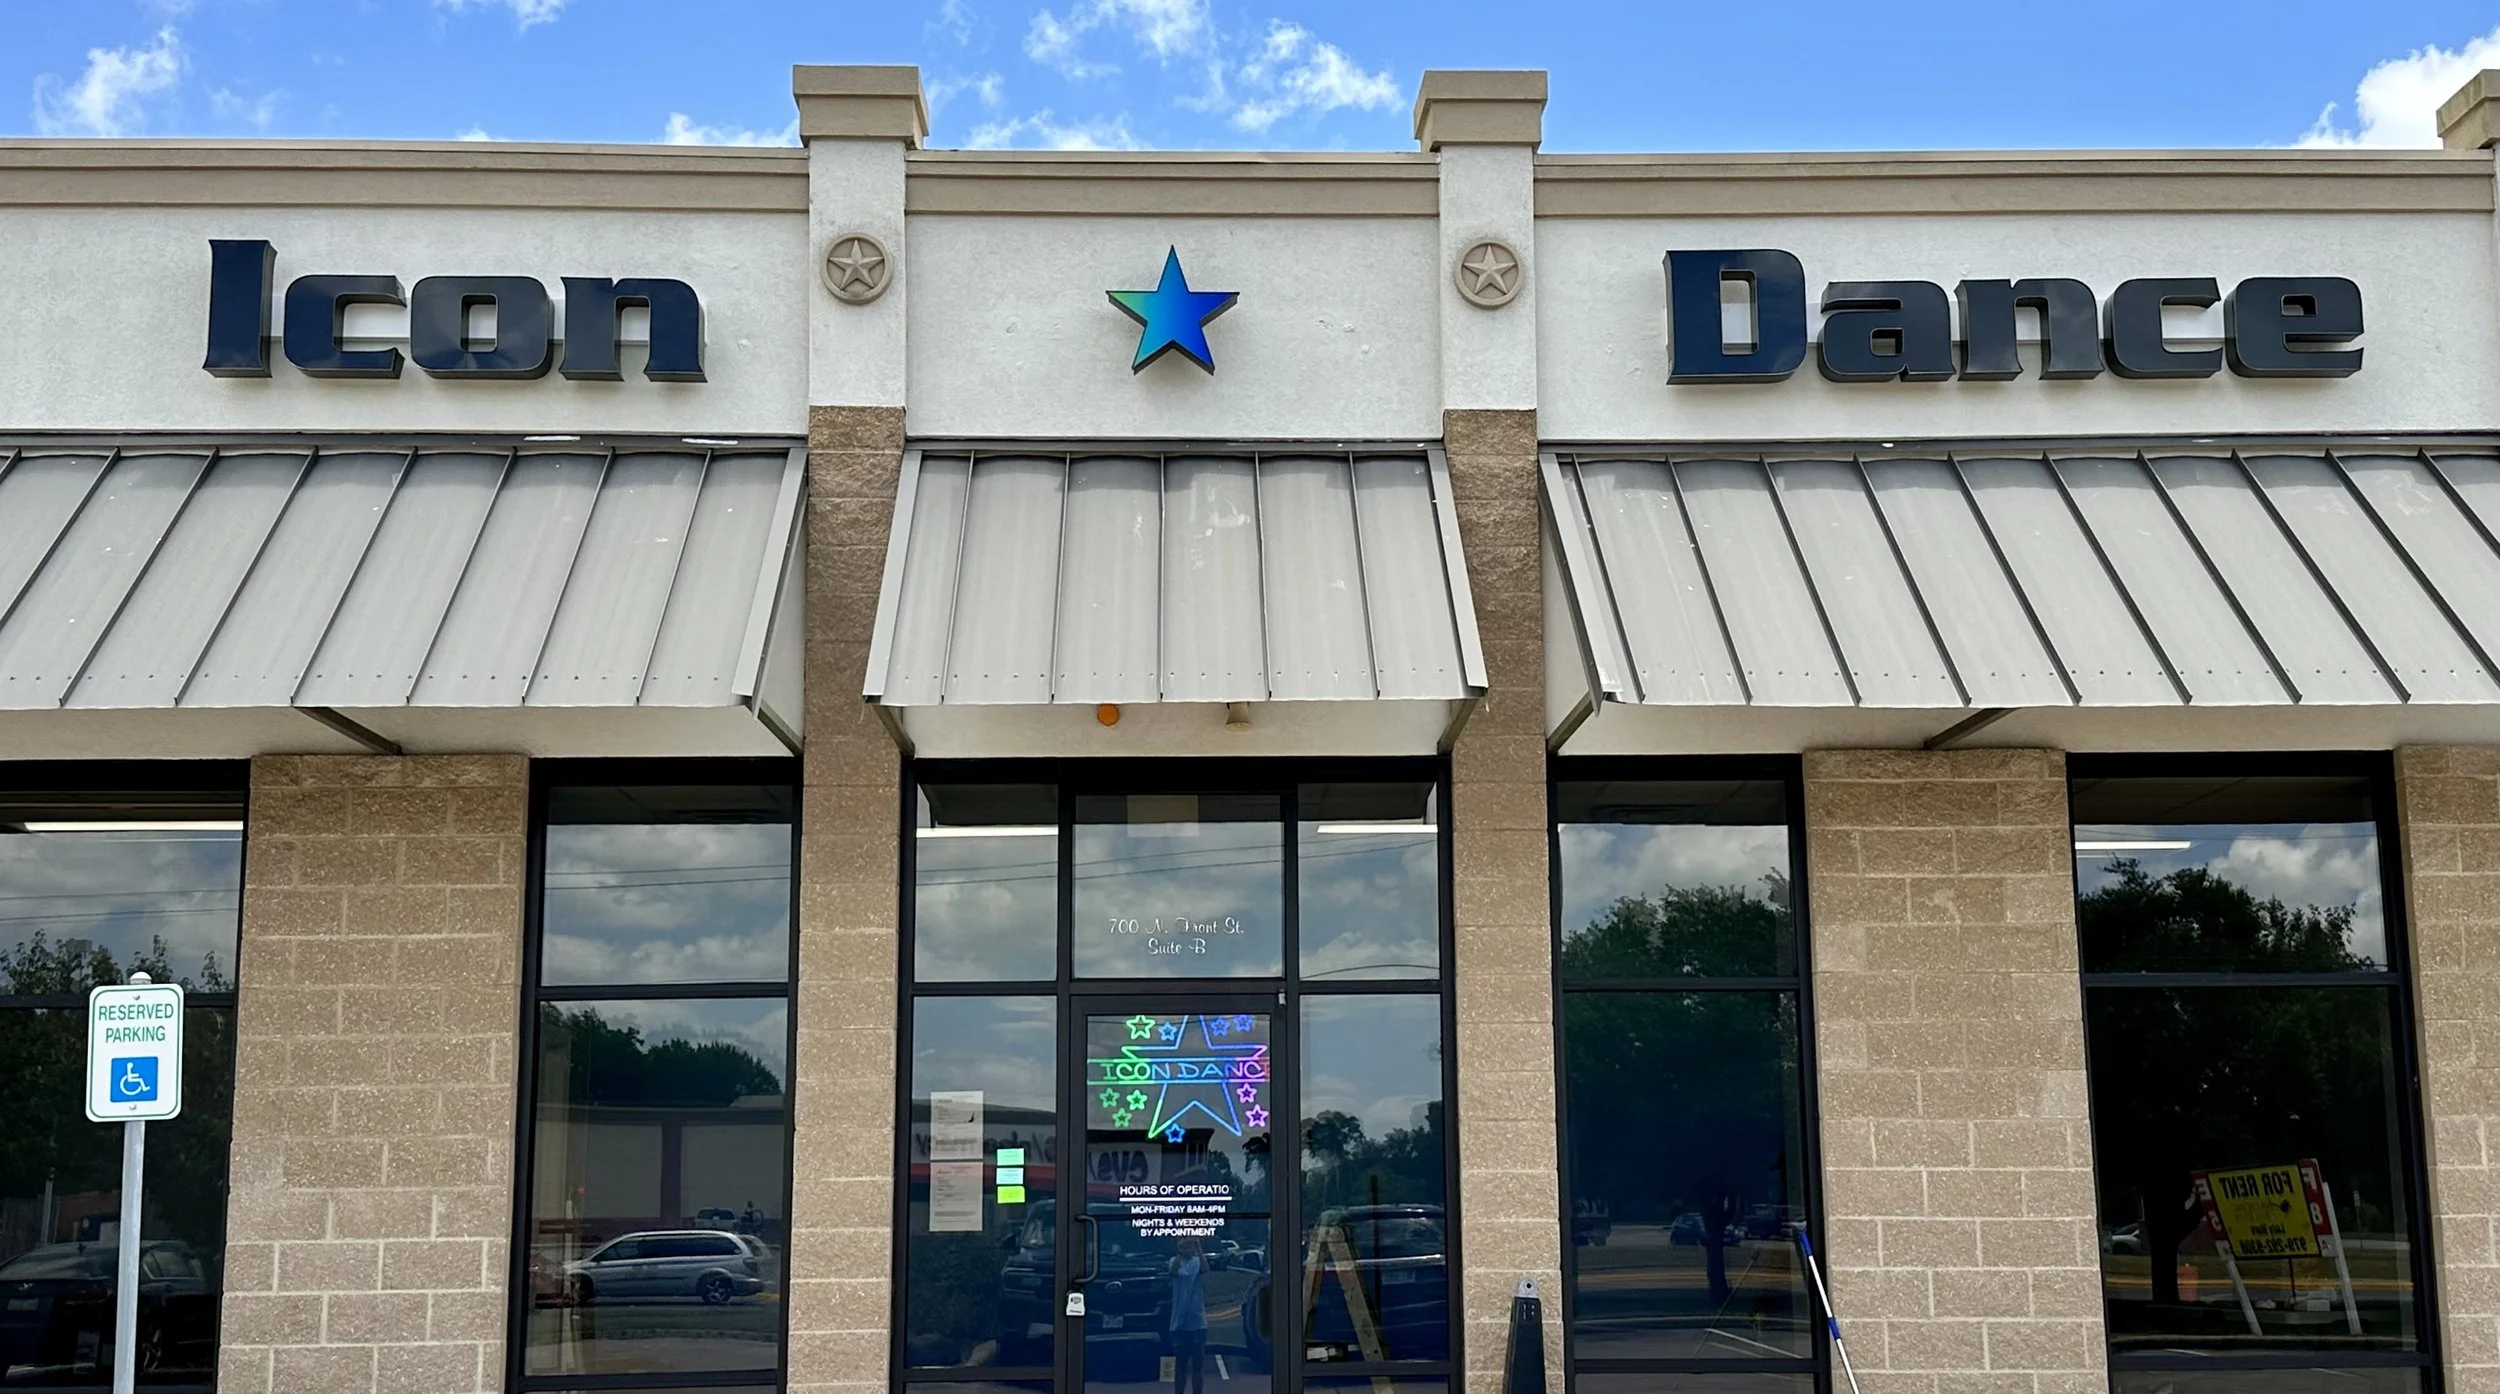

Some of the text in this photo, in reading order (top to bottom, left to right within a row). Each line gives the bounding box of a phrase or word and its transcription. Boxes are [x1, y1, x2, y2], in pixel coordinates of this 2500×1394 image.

[203, 239, 2364, 385] Icon Dance
[1108, 918, 1139, 934] 700
[1175, 917, 1217, 934] Front
[1223, 917, 1244, 934] St.
[1147, 938, 1183, 955] Suite
[98, 1003, 174, 1021] RESERVED
[105, 1025, 166, 1043] PARKING
[1100, 1062, 1171, 1080] ICON
[1120, 1185, 1235, 1195] HOURS OF OPERATIO
[1131, 1205, 1225, 1214] MON-FRIDAY 8AM-4PM
[1132, 1218, 1225, 1227] NIGHTS & WEEKENDS
[1140, 1228, 1216, 1237] BY APPOINTMENT
